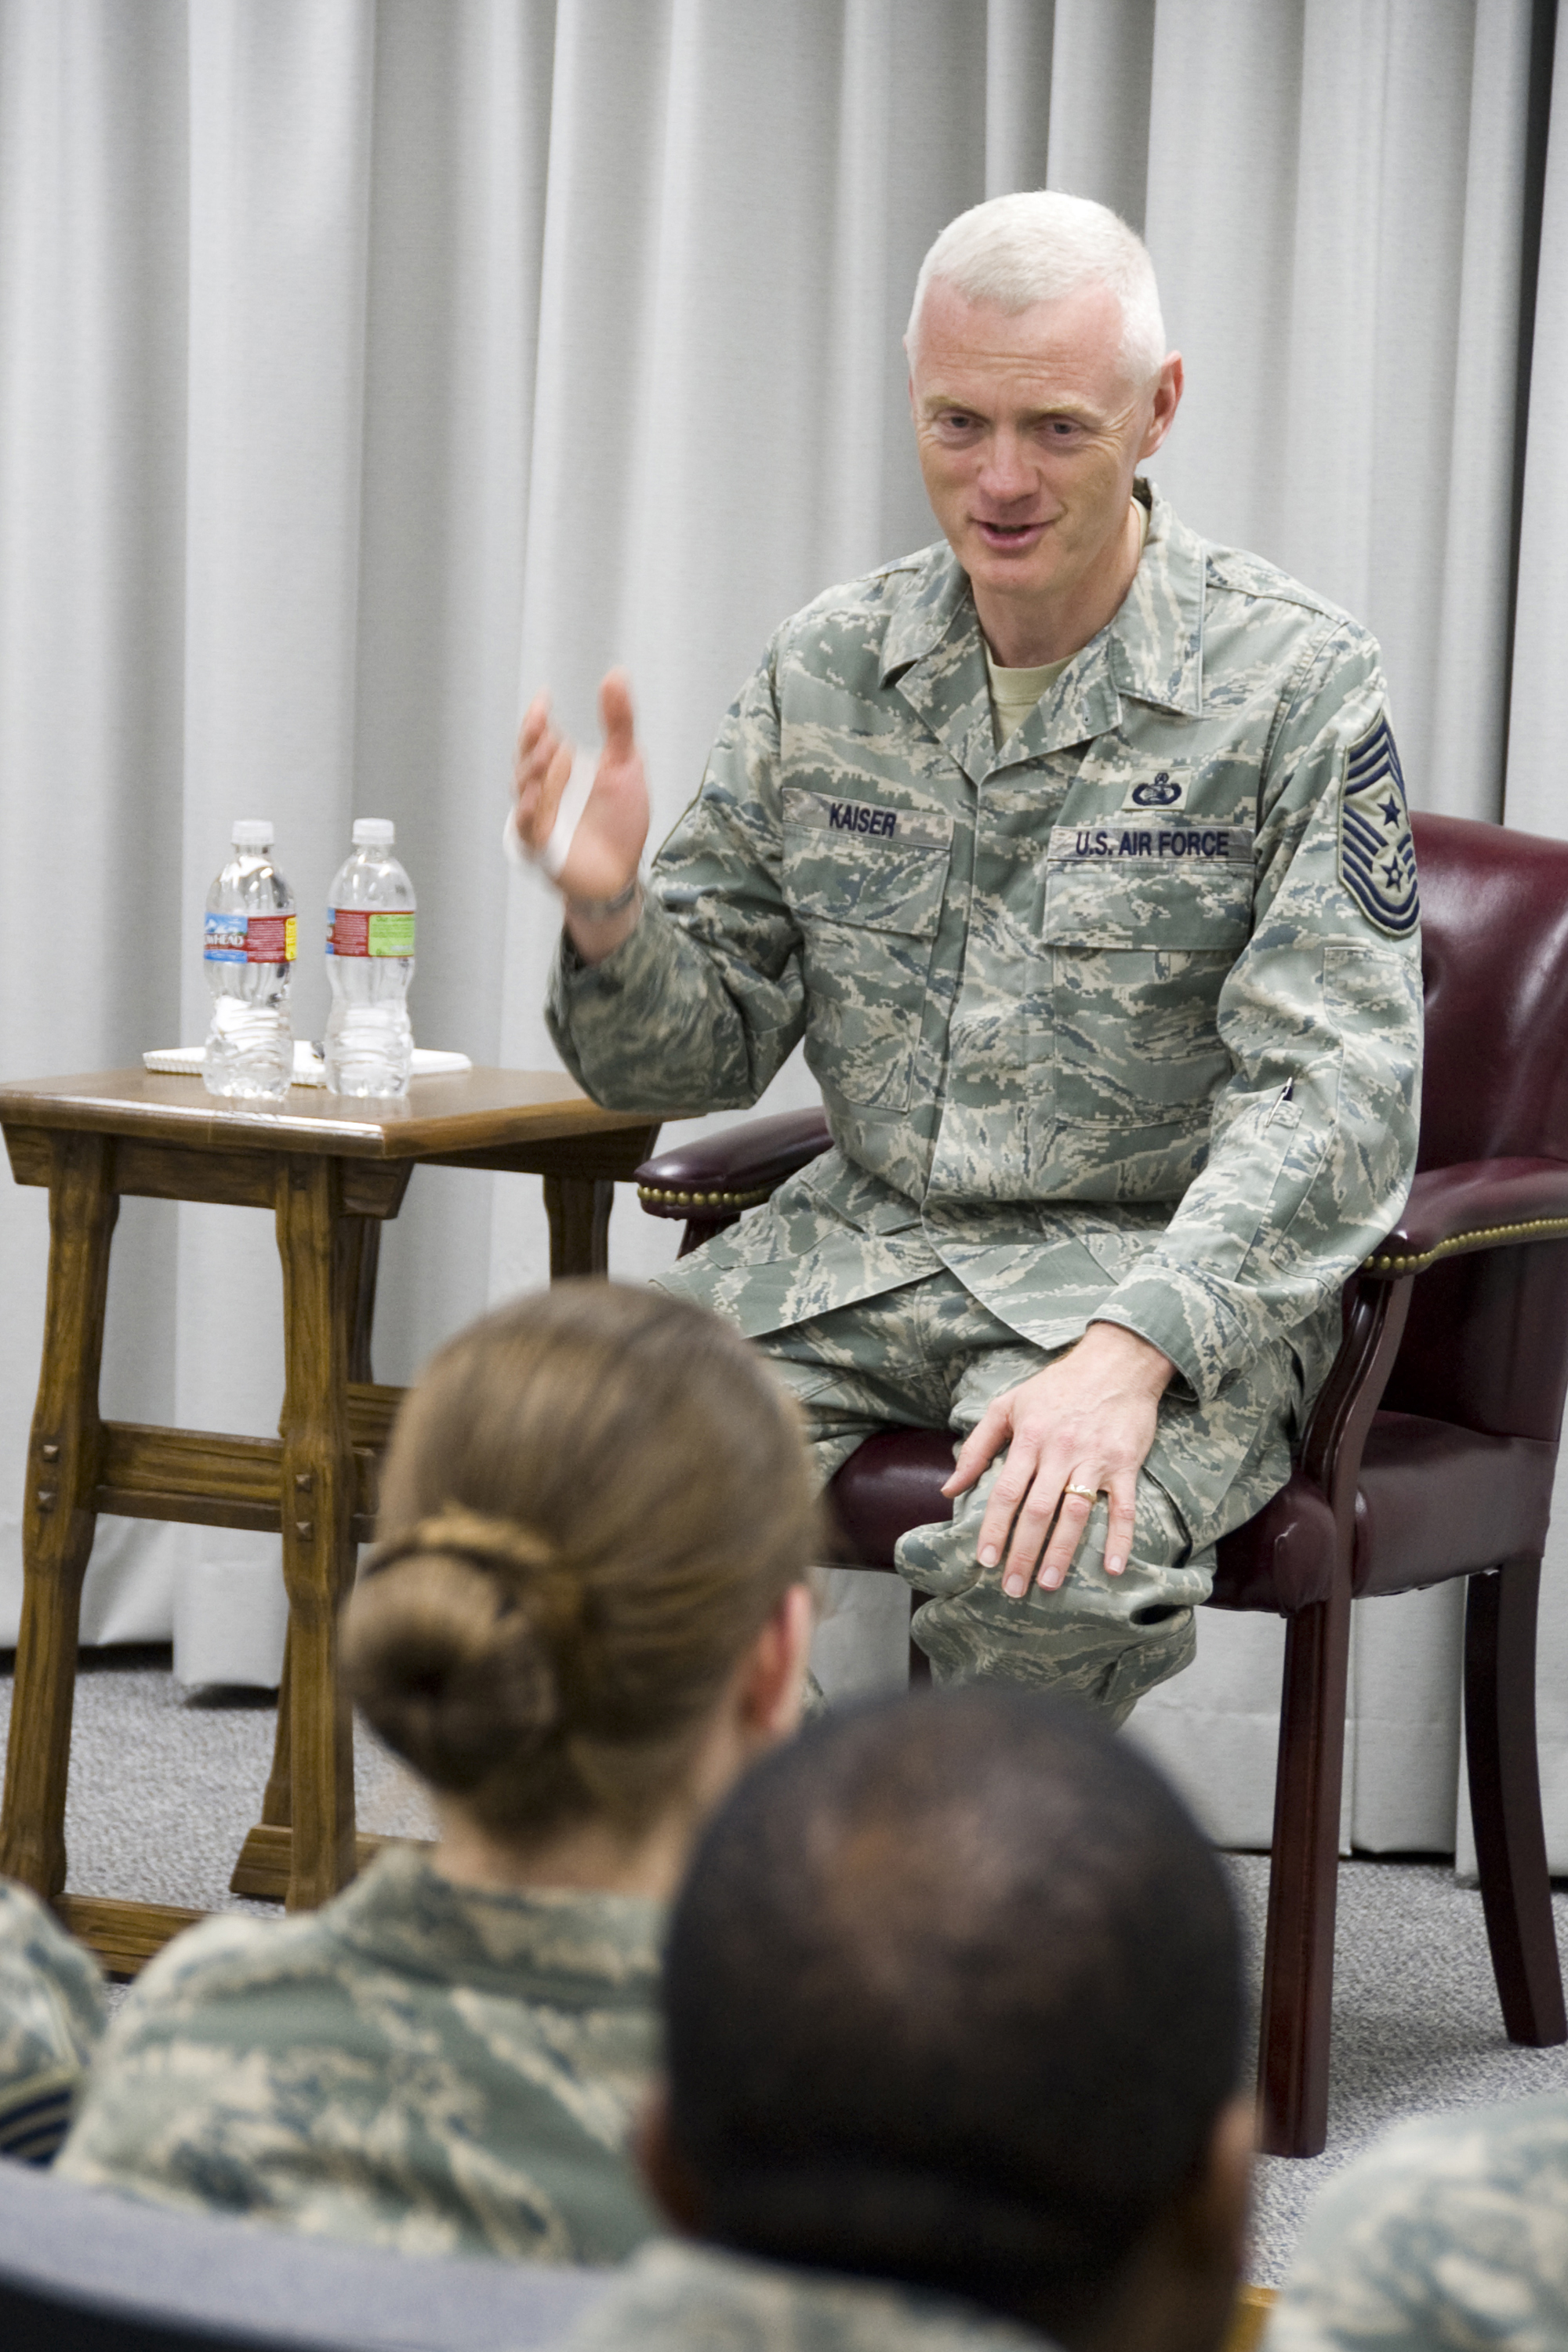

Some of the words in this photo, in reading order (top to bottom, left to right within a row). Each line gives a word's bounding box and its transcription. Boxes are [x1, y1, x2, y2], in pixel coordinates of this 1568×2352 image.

[829, 803, 897, 837] KAISER
[1076, 831, 1112, 855] U.S.
[1118, 831, 1152, 856] AIR
[1158, 831, 1229, 856] FORCE
